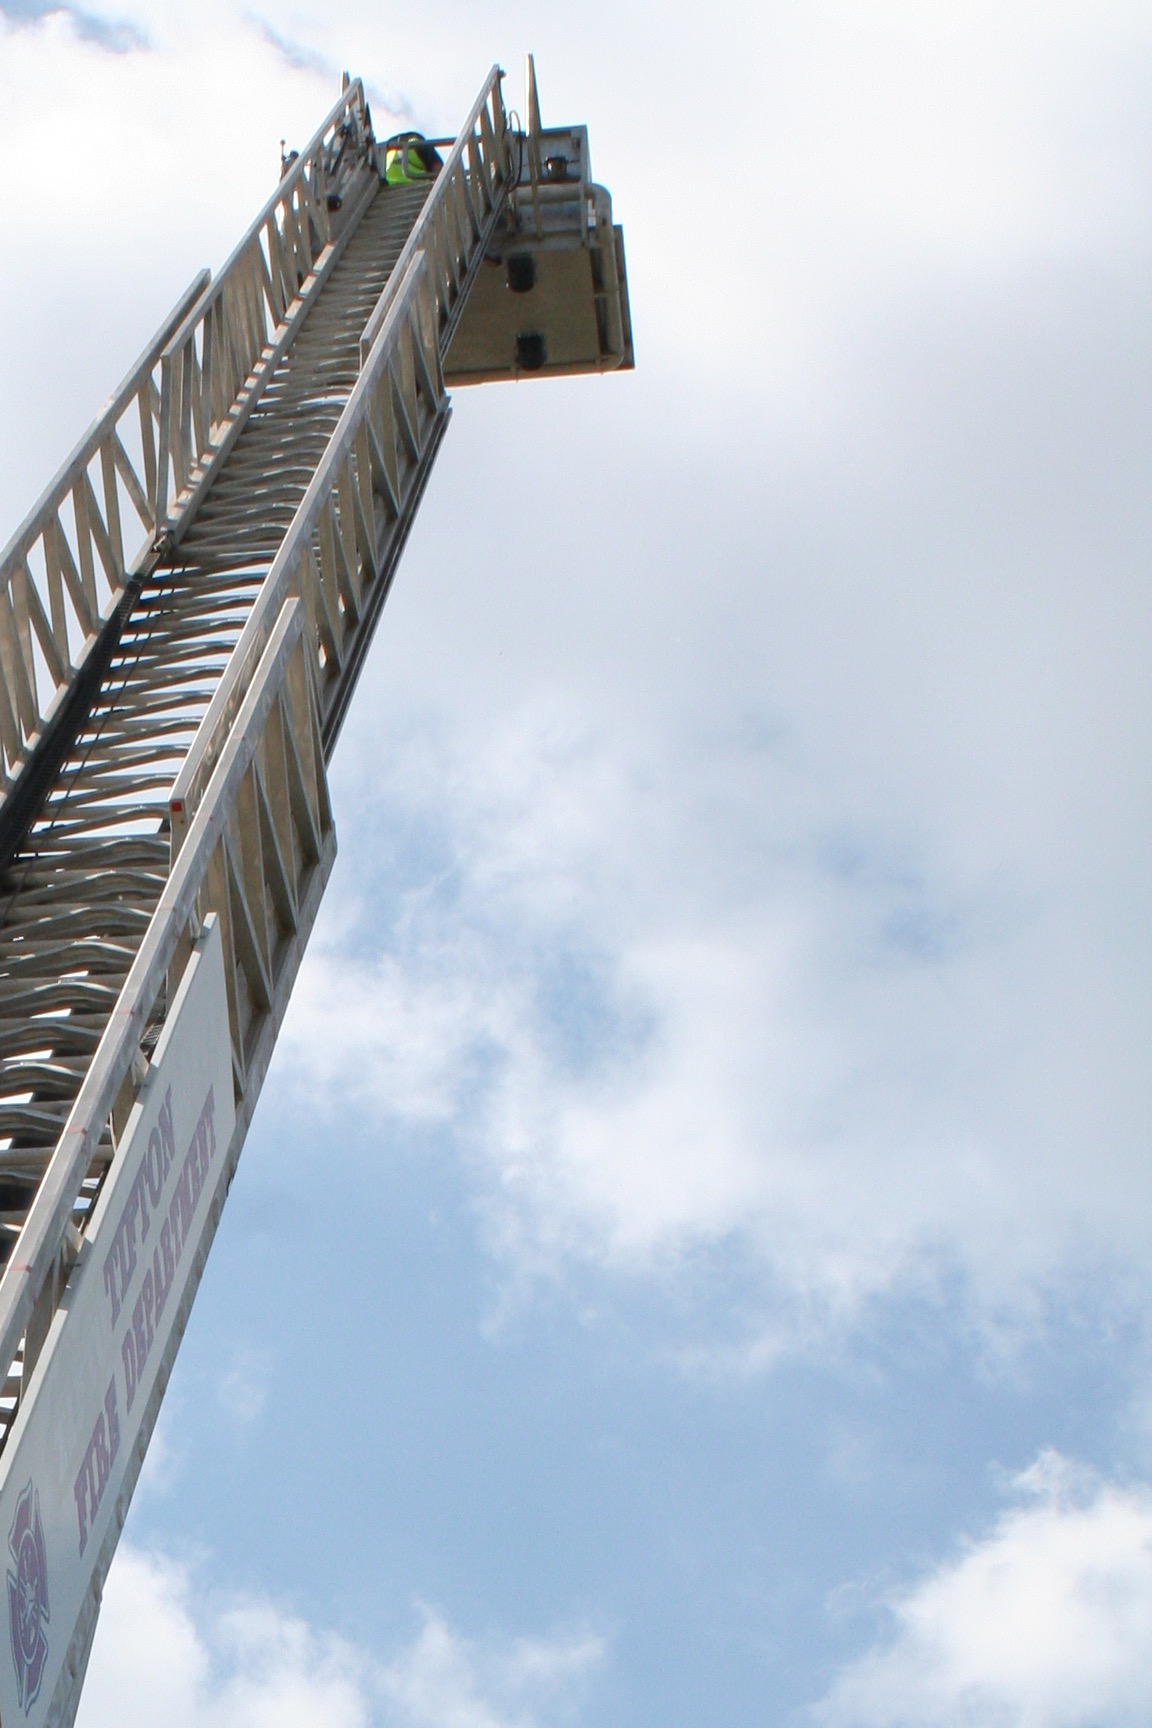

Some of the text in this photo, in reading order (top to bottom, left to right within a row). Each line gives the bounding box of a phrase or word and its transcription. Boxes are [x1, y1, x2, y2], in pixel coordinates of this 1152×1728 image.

[74, 1084, 218, 1560] FIRE DEPARTMENT
[103, 1083, 176, 1332] TIPTON
